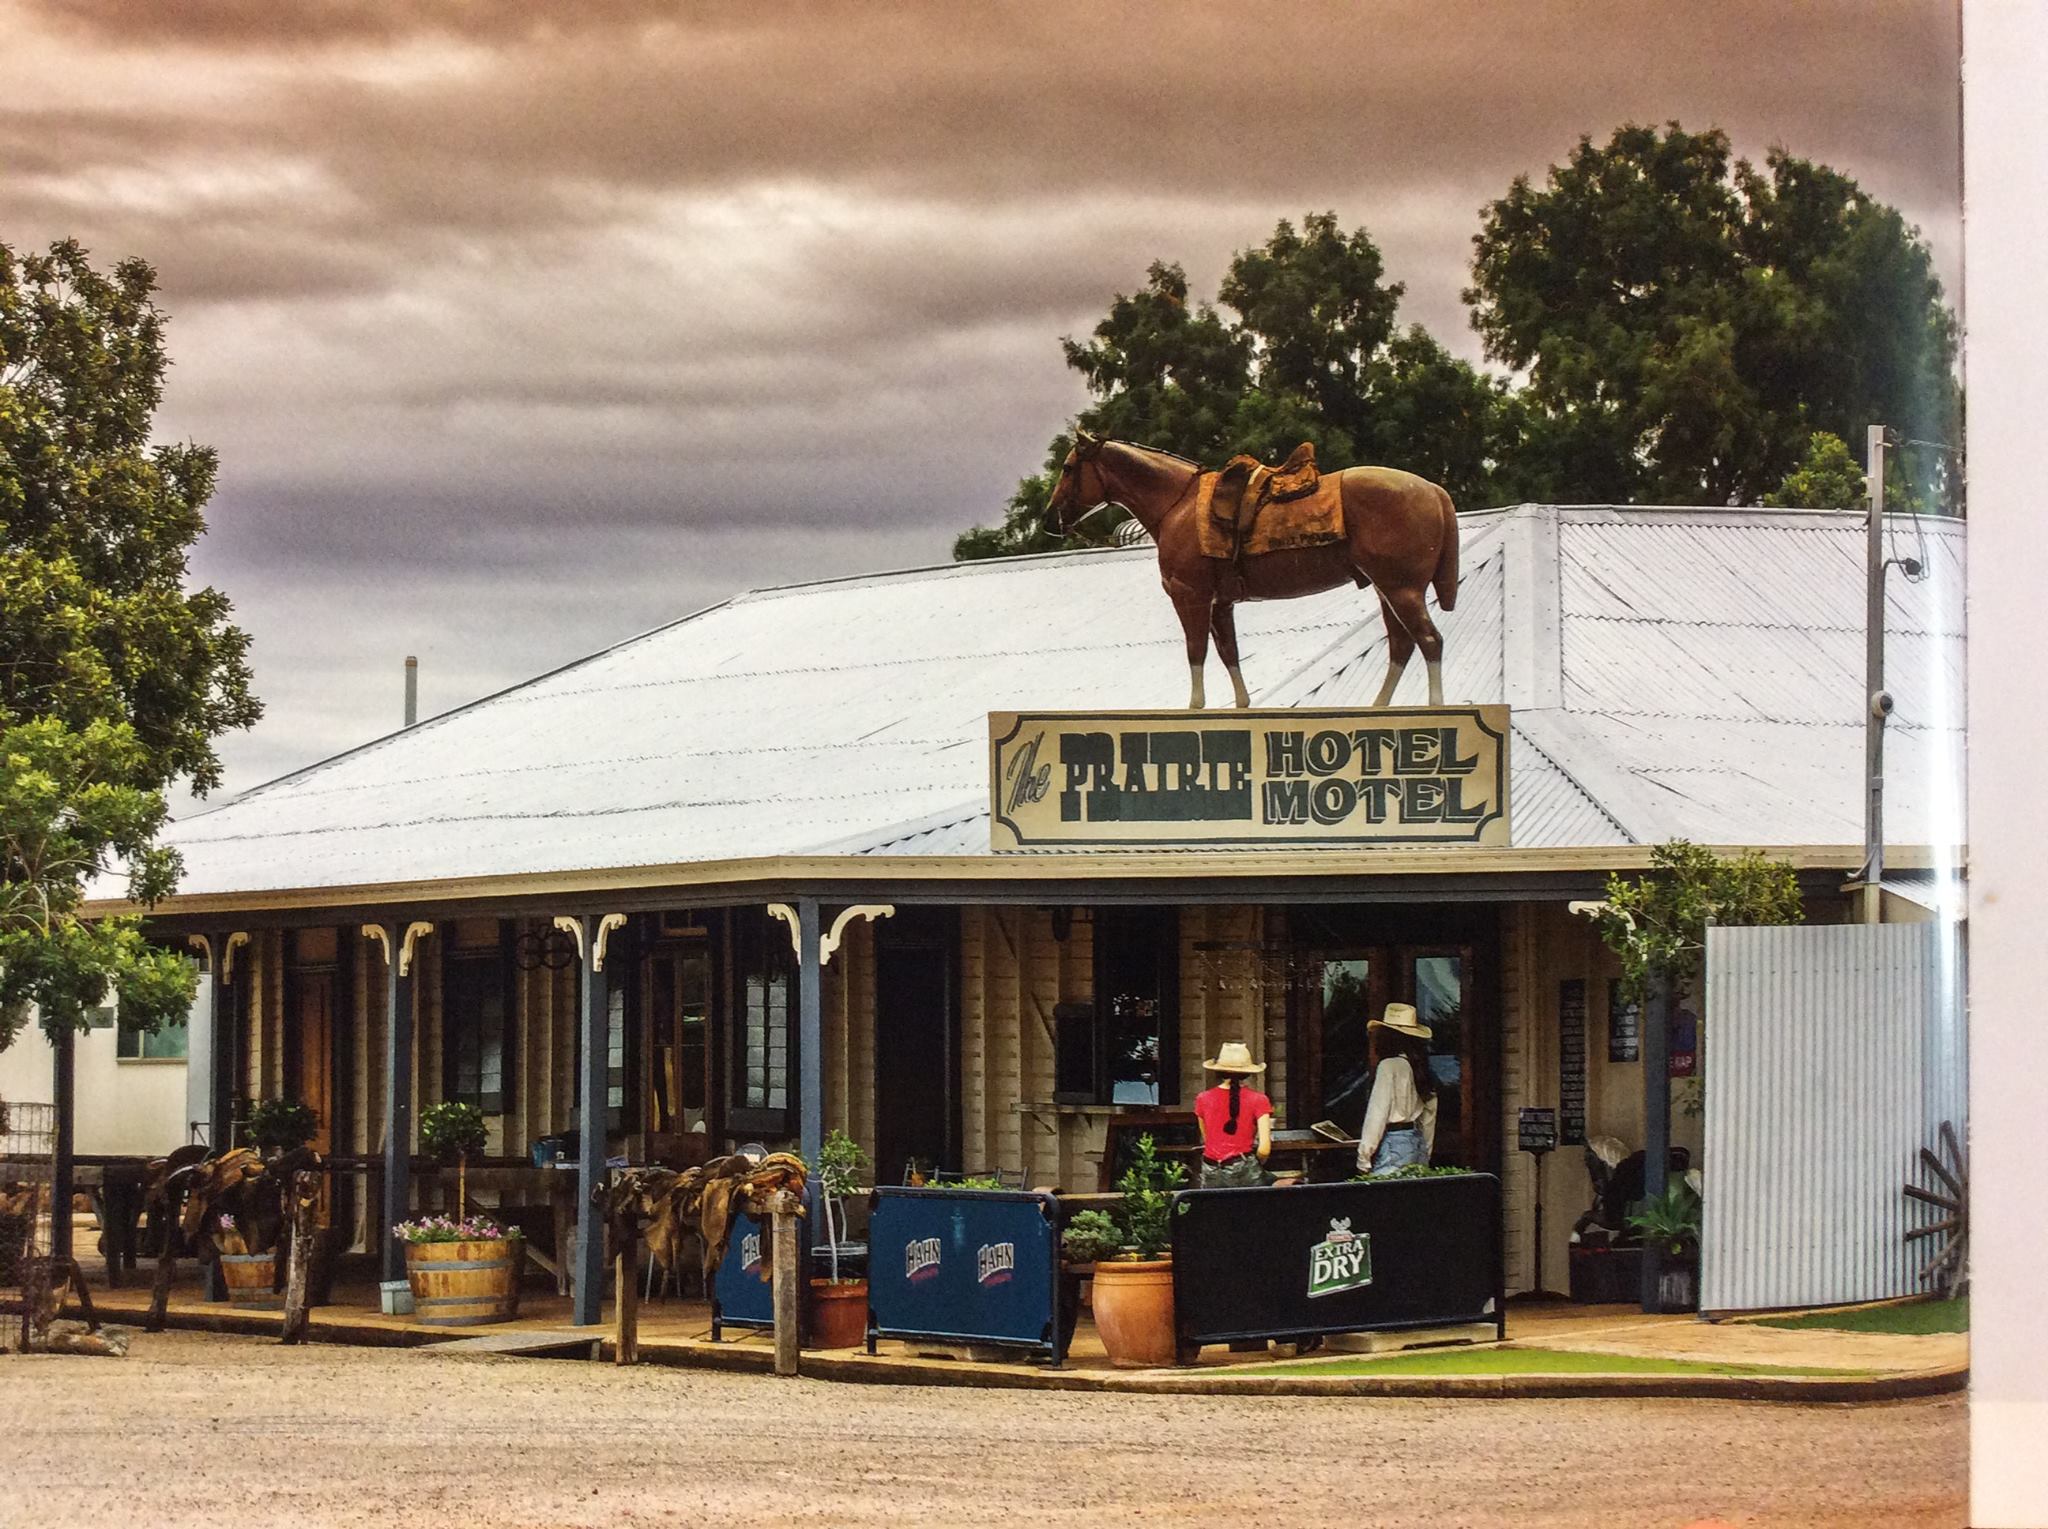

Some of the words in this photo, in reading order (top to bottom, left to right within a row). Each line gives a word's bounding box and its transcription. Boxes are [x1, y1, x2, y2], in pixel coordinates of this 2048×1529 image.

[1264, 727, 1481, 777] HOTEL
[1005, 730, 1051, 814] The
[1060, 730, 1252, 822] PRAIRIE
[1261, 777, 1489, 825] MOTEL
[741, 1233, 761, 1270] HA
[905, 1237, 942, 1279] HAHN
[977, 1242, 1014, 1284] HAHN
[1313, 1249, 1365, 1284] DRY
[1315, 1239, 1364, 1261] EXTRA
